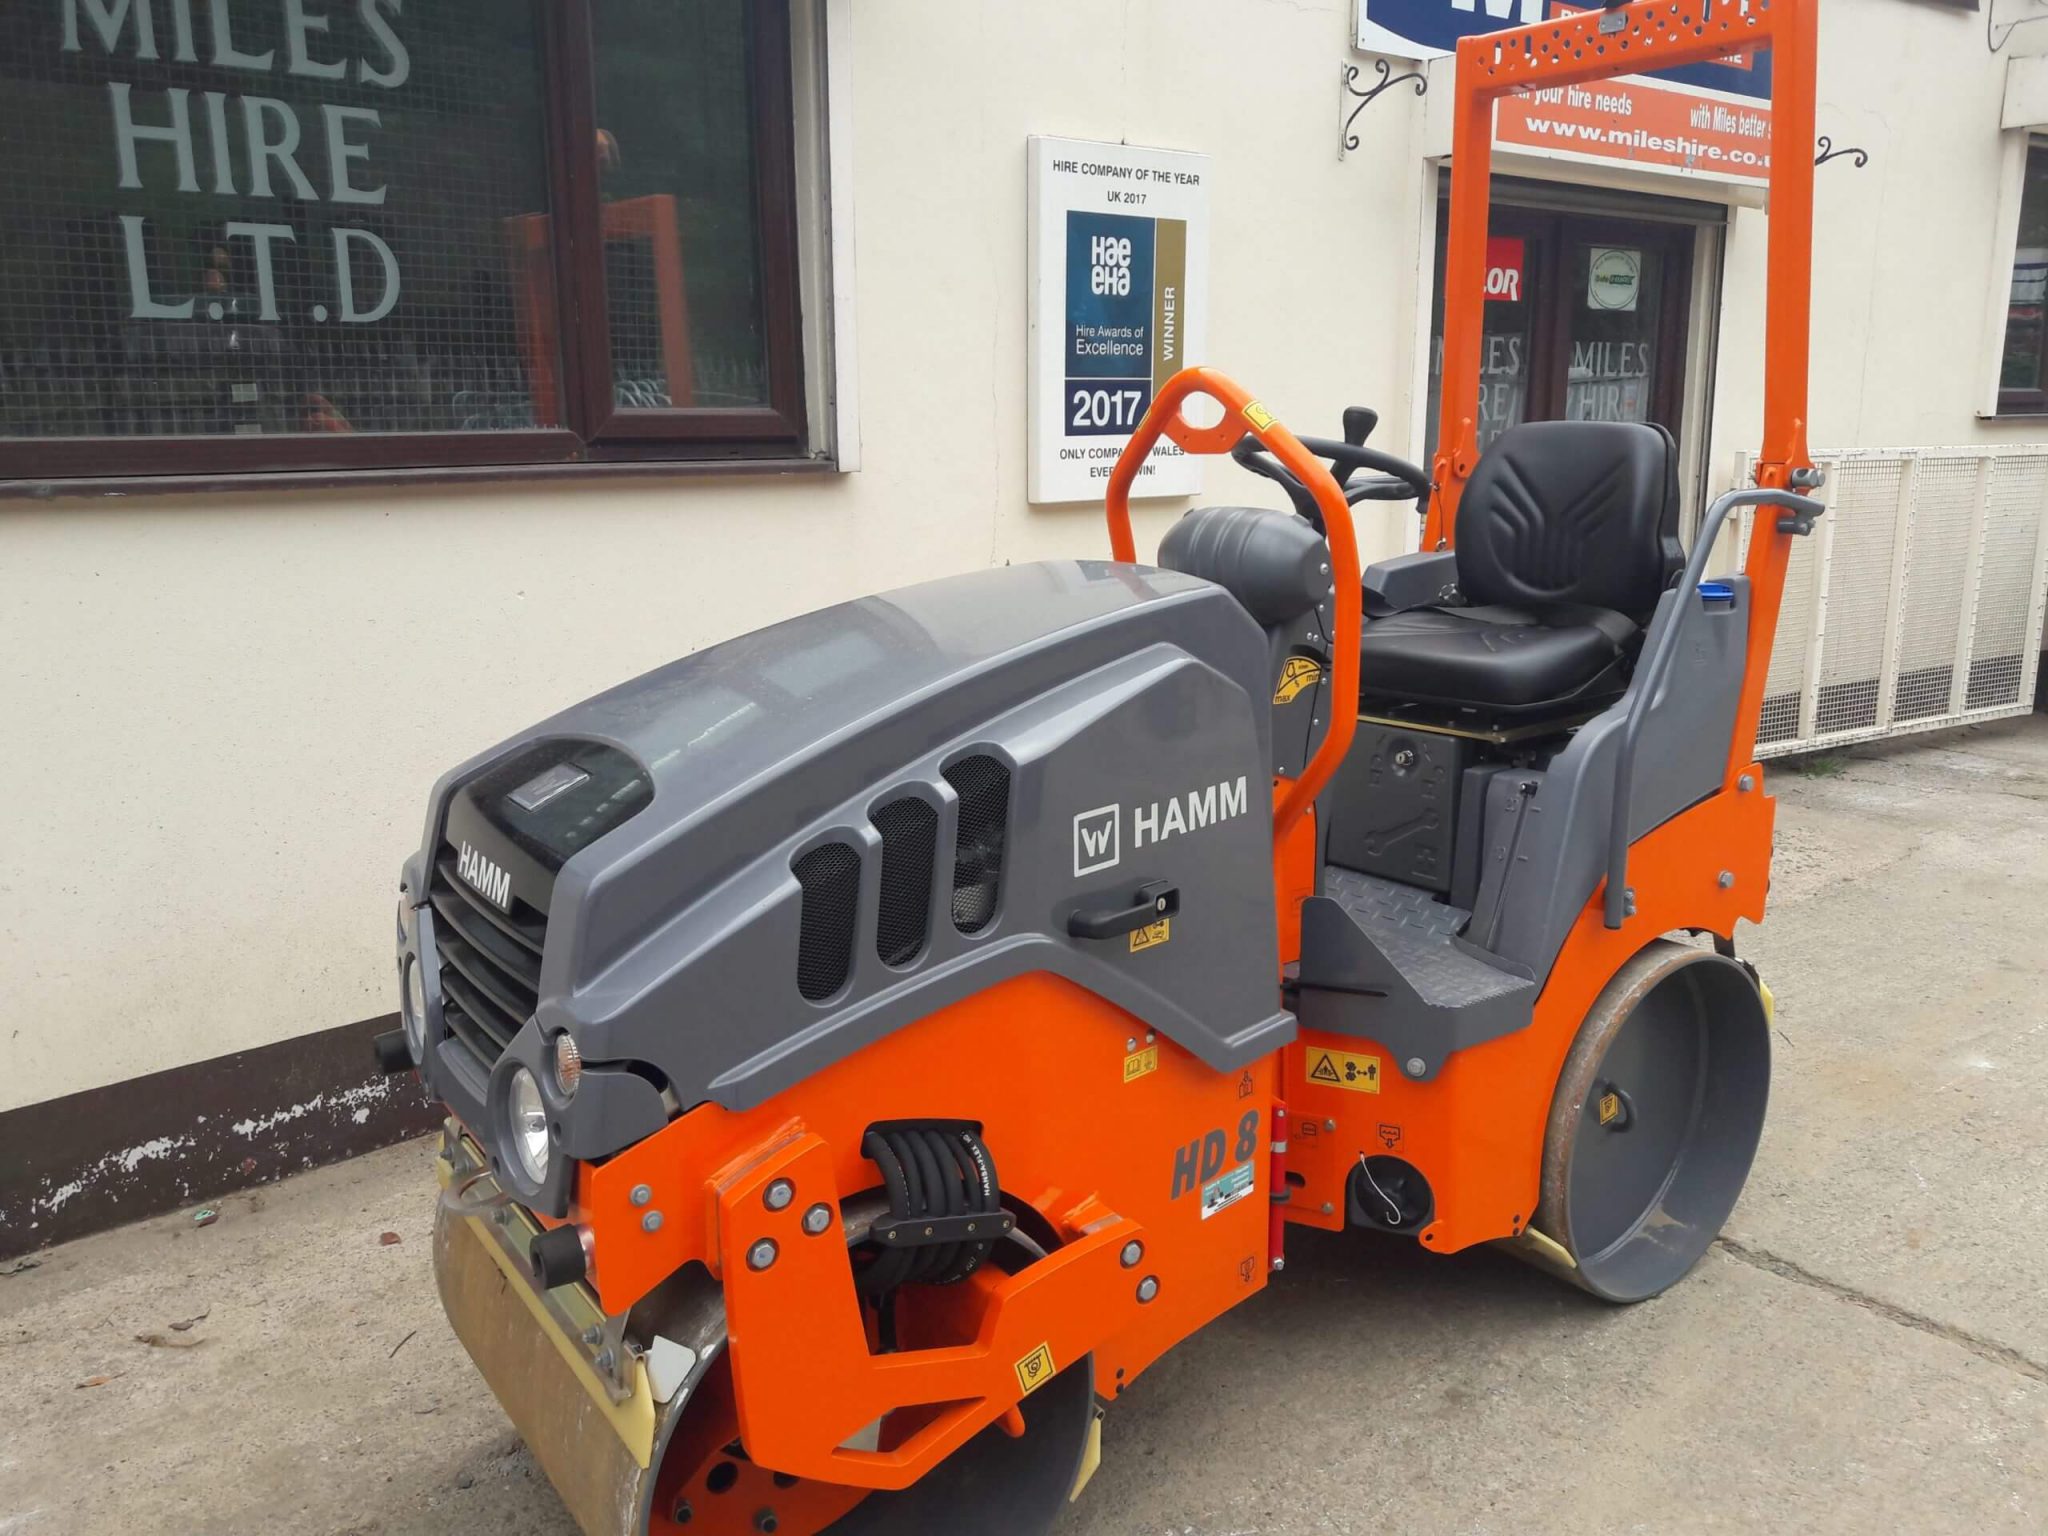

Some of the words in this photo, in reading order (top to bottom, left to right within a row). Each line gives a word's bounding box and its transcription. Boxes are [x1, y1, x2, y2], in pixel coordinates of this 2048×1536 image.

[1567, 85, 1591, 109] hire
[1595, 92, 1632, 115] needs
[1690, 103, 1711, 128] with
[1713, 106, 1737, 134] Miles
[1739, 111, 1766, 137] better
[109, 82, 387, 205] HIRE
[1525, 116, 1771, 168] www.mileshire.co.
[1053, 159, 1078, 173] HIRE
[1081, 162, 1132, 179] COMPANY
[1135, 168, 1150, 180] OF
[1152, 170, 1171, 183] THE
[1174, 172, 1200, 186] YEAR
[1107, 190, 1121, 203] UK
[1124, 192, 1147, 204] 2017
[118, 215, 401, 323] L.T.D
[1484, 267, 1518, 301] OR
[1076, 324, 1095, 337] Hire
[1097, 325, 1132, 338] Awards
[1134, 326, 1144, 338] of
[1163, 287, 1175, 361] WINNER
[1076, 338, 1144, 356] Excellence
[1574, 341, 1649, 377] MILES
[1072, 389, 1142, 427] 2017
[1060, 448, 1086, 460] ONLY
[1088, 447, 1123, 459] COMPA
[1153, 446, 1185, 457] WALES
[1134, 775, 1247, 848] HAMM
[458, 841, 511, 908] HAMM
[1171, 1128, 1227, 1200] HD
[1235, 1110, 1259, 1163] 8
